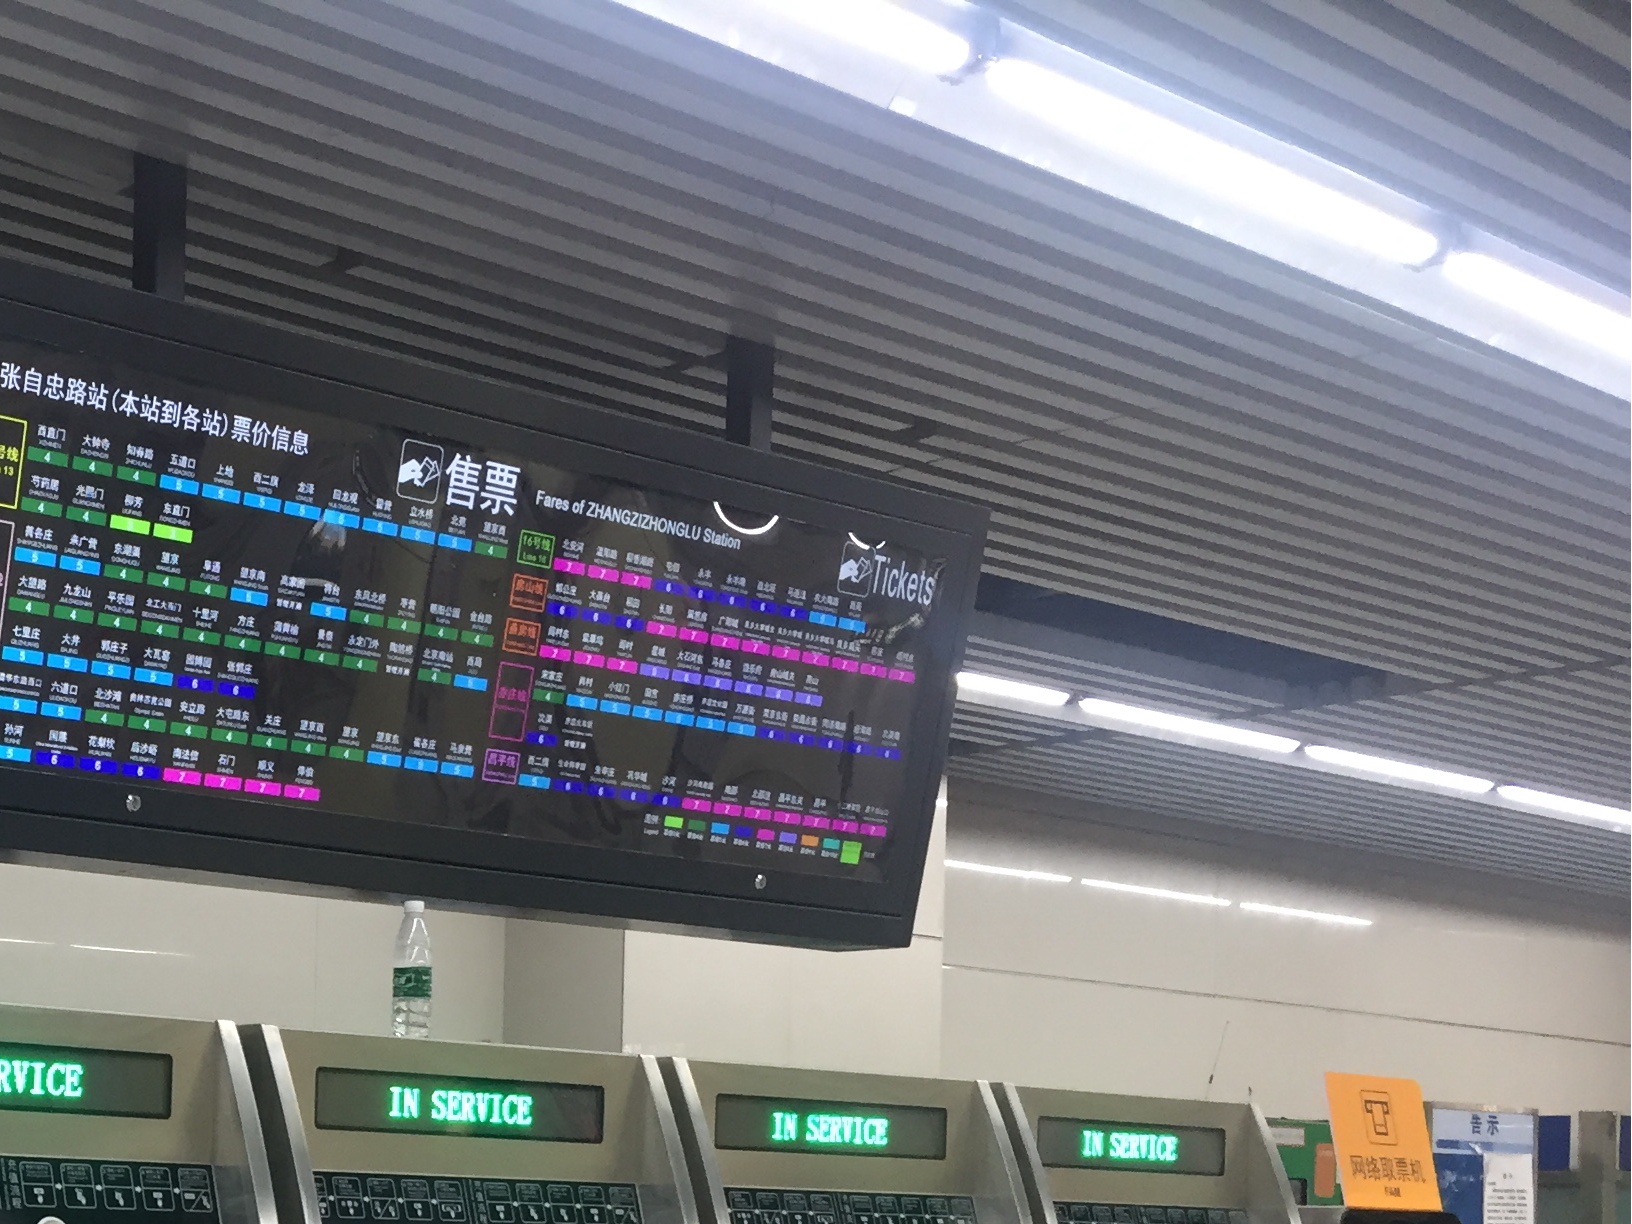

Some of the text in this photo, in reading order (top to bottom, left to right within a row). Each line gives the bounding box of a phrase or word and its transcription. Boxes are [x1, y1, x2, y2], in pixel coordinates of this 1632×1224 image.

[0, 361, 309, 455] 张自忠路站(本站到各站)票价信息
[3, 466, 14, 476] 13
[445, 453, 521, 516] 售票
[536, 490, 741, 550] Fares of ZHANGZIZHONGLU Station
[872, 555, 936, 606] Tickets
[389, 1087, 532, 1124] IN SERVICE
[772, 1113, 887, 1145] IN SERVICE
[1470, 1114, 1499, 1136] 告示
[1083, 1131, 1177, 1160] IN SERVICE
[1349, 1155, 1426, 1183] 网络取票机
